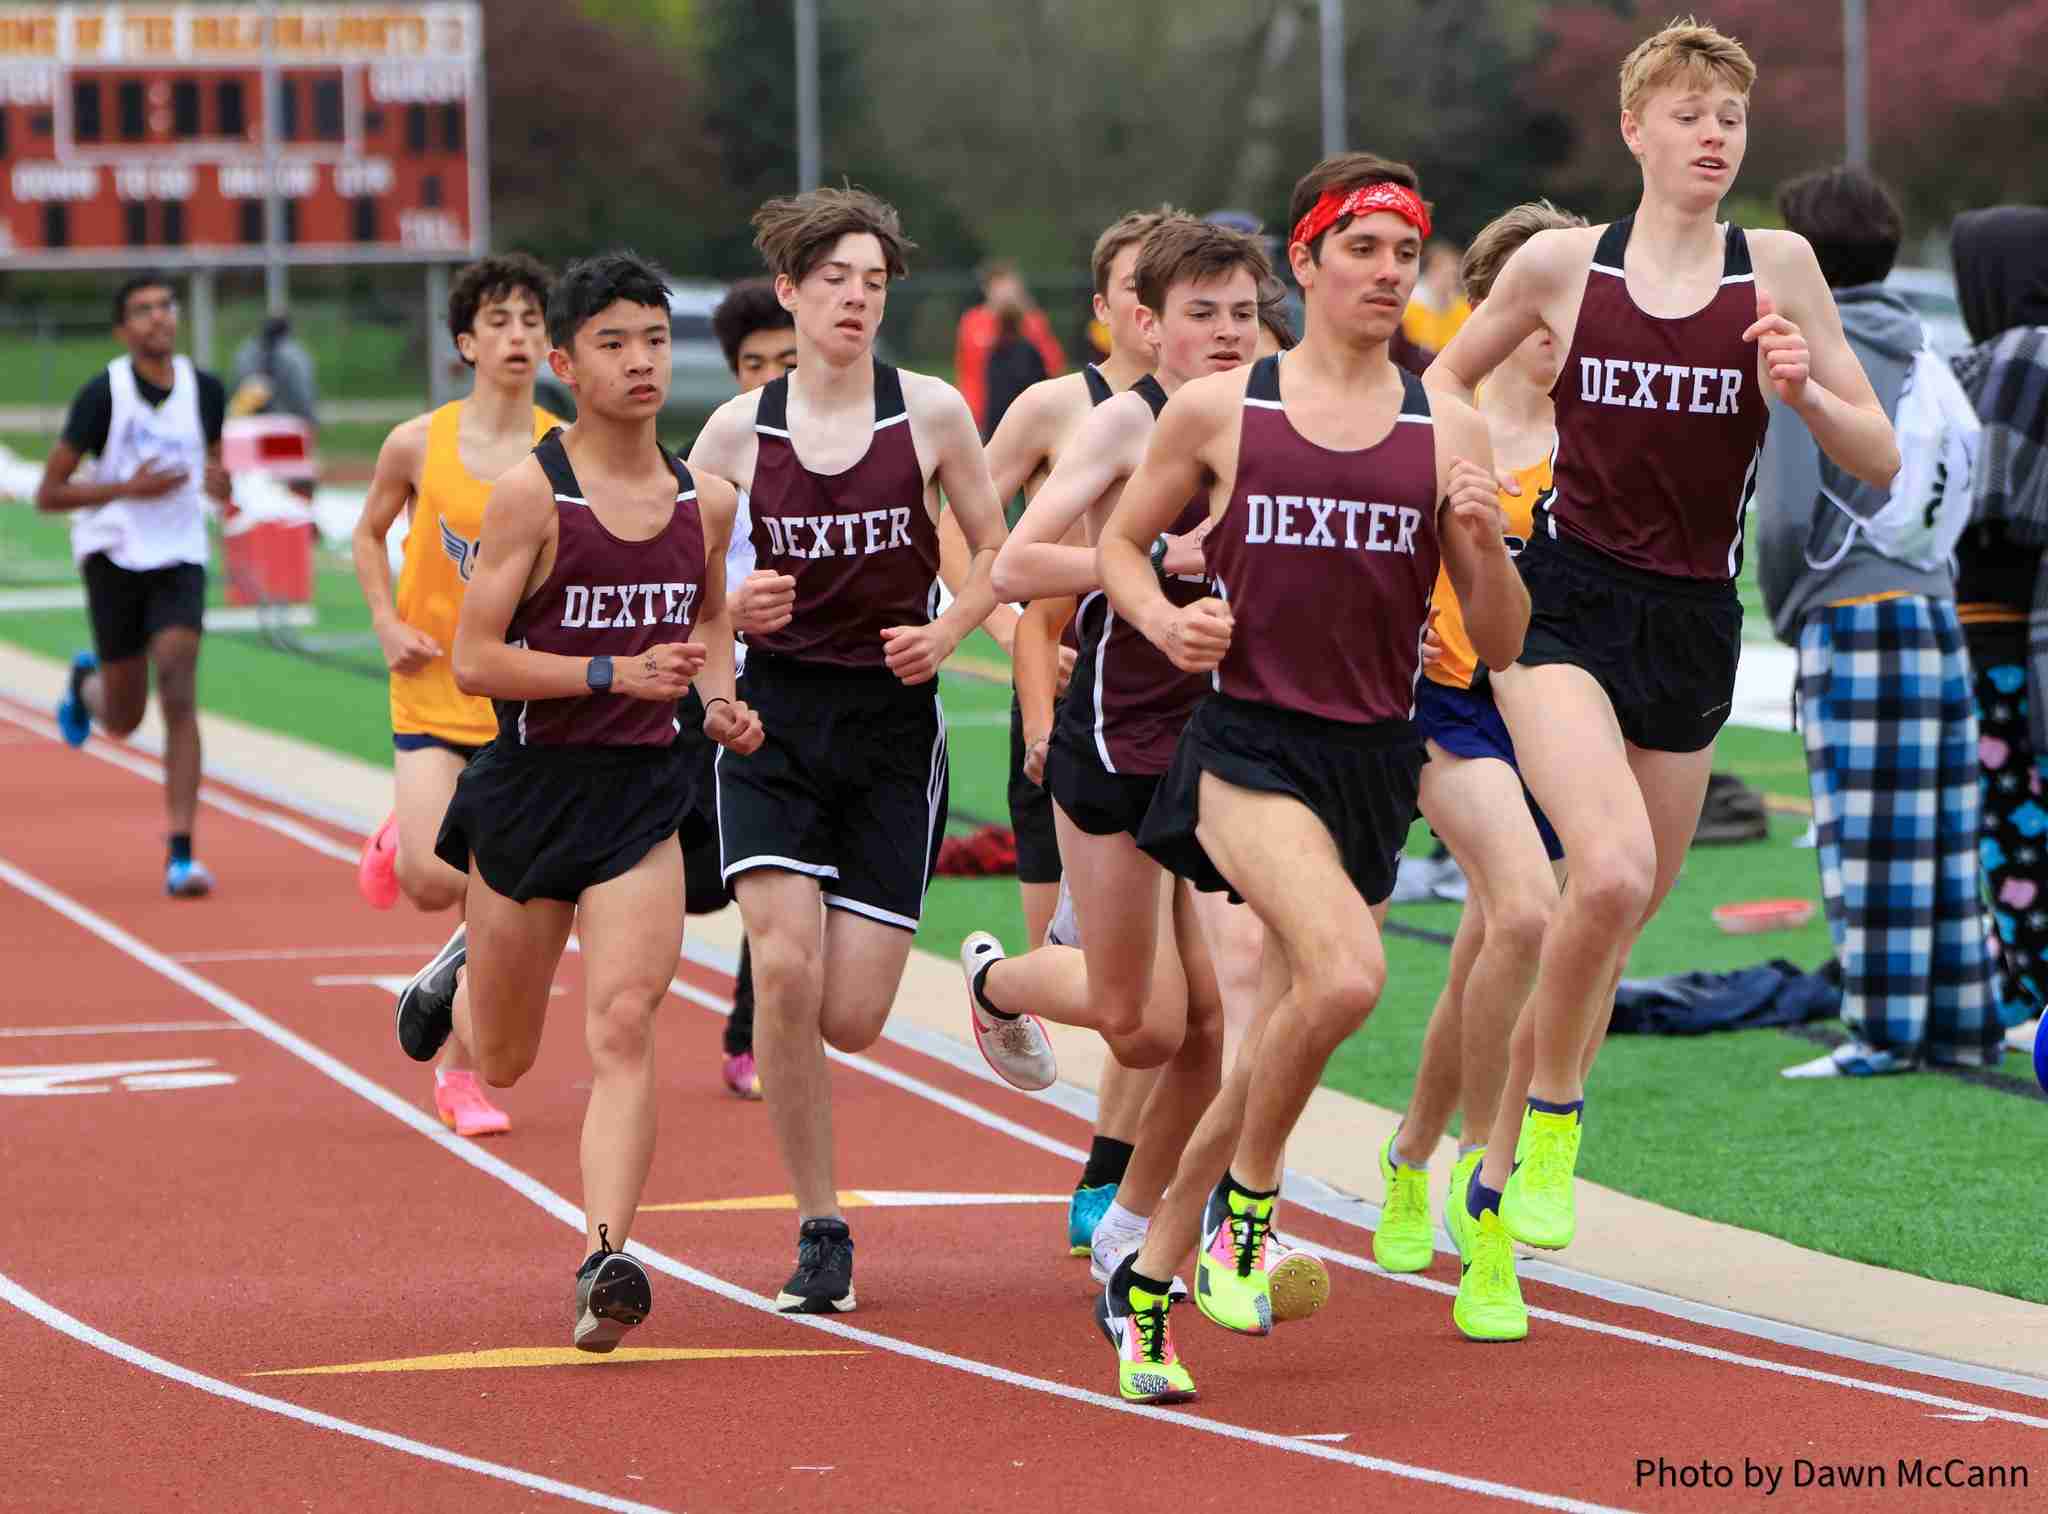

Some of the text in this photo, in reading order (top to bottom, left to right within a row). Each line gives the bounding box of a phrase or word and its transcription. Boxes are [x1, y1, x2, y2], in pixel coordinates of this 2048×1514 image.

[1580, 356, 1742, 414] DEXTER
[762, 506, 911, 560] DEXTER
[1245, 494, 1421, 554] DEXTER
[560, 582, 698, 629] DEXTER
